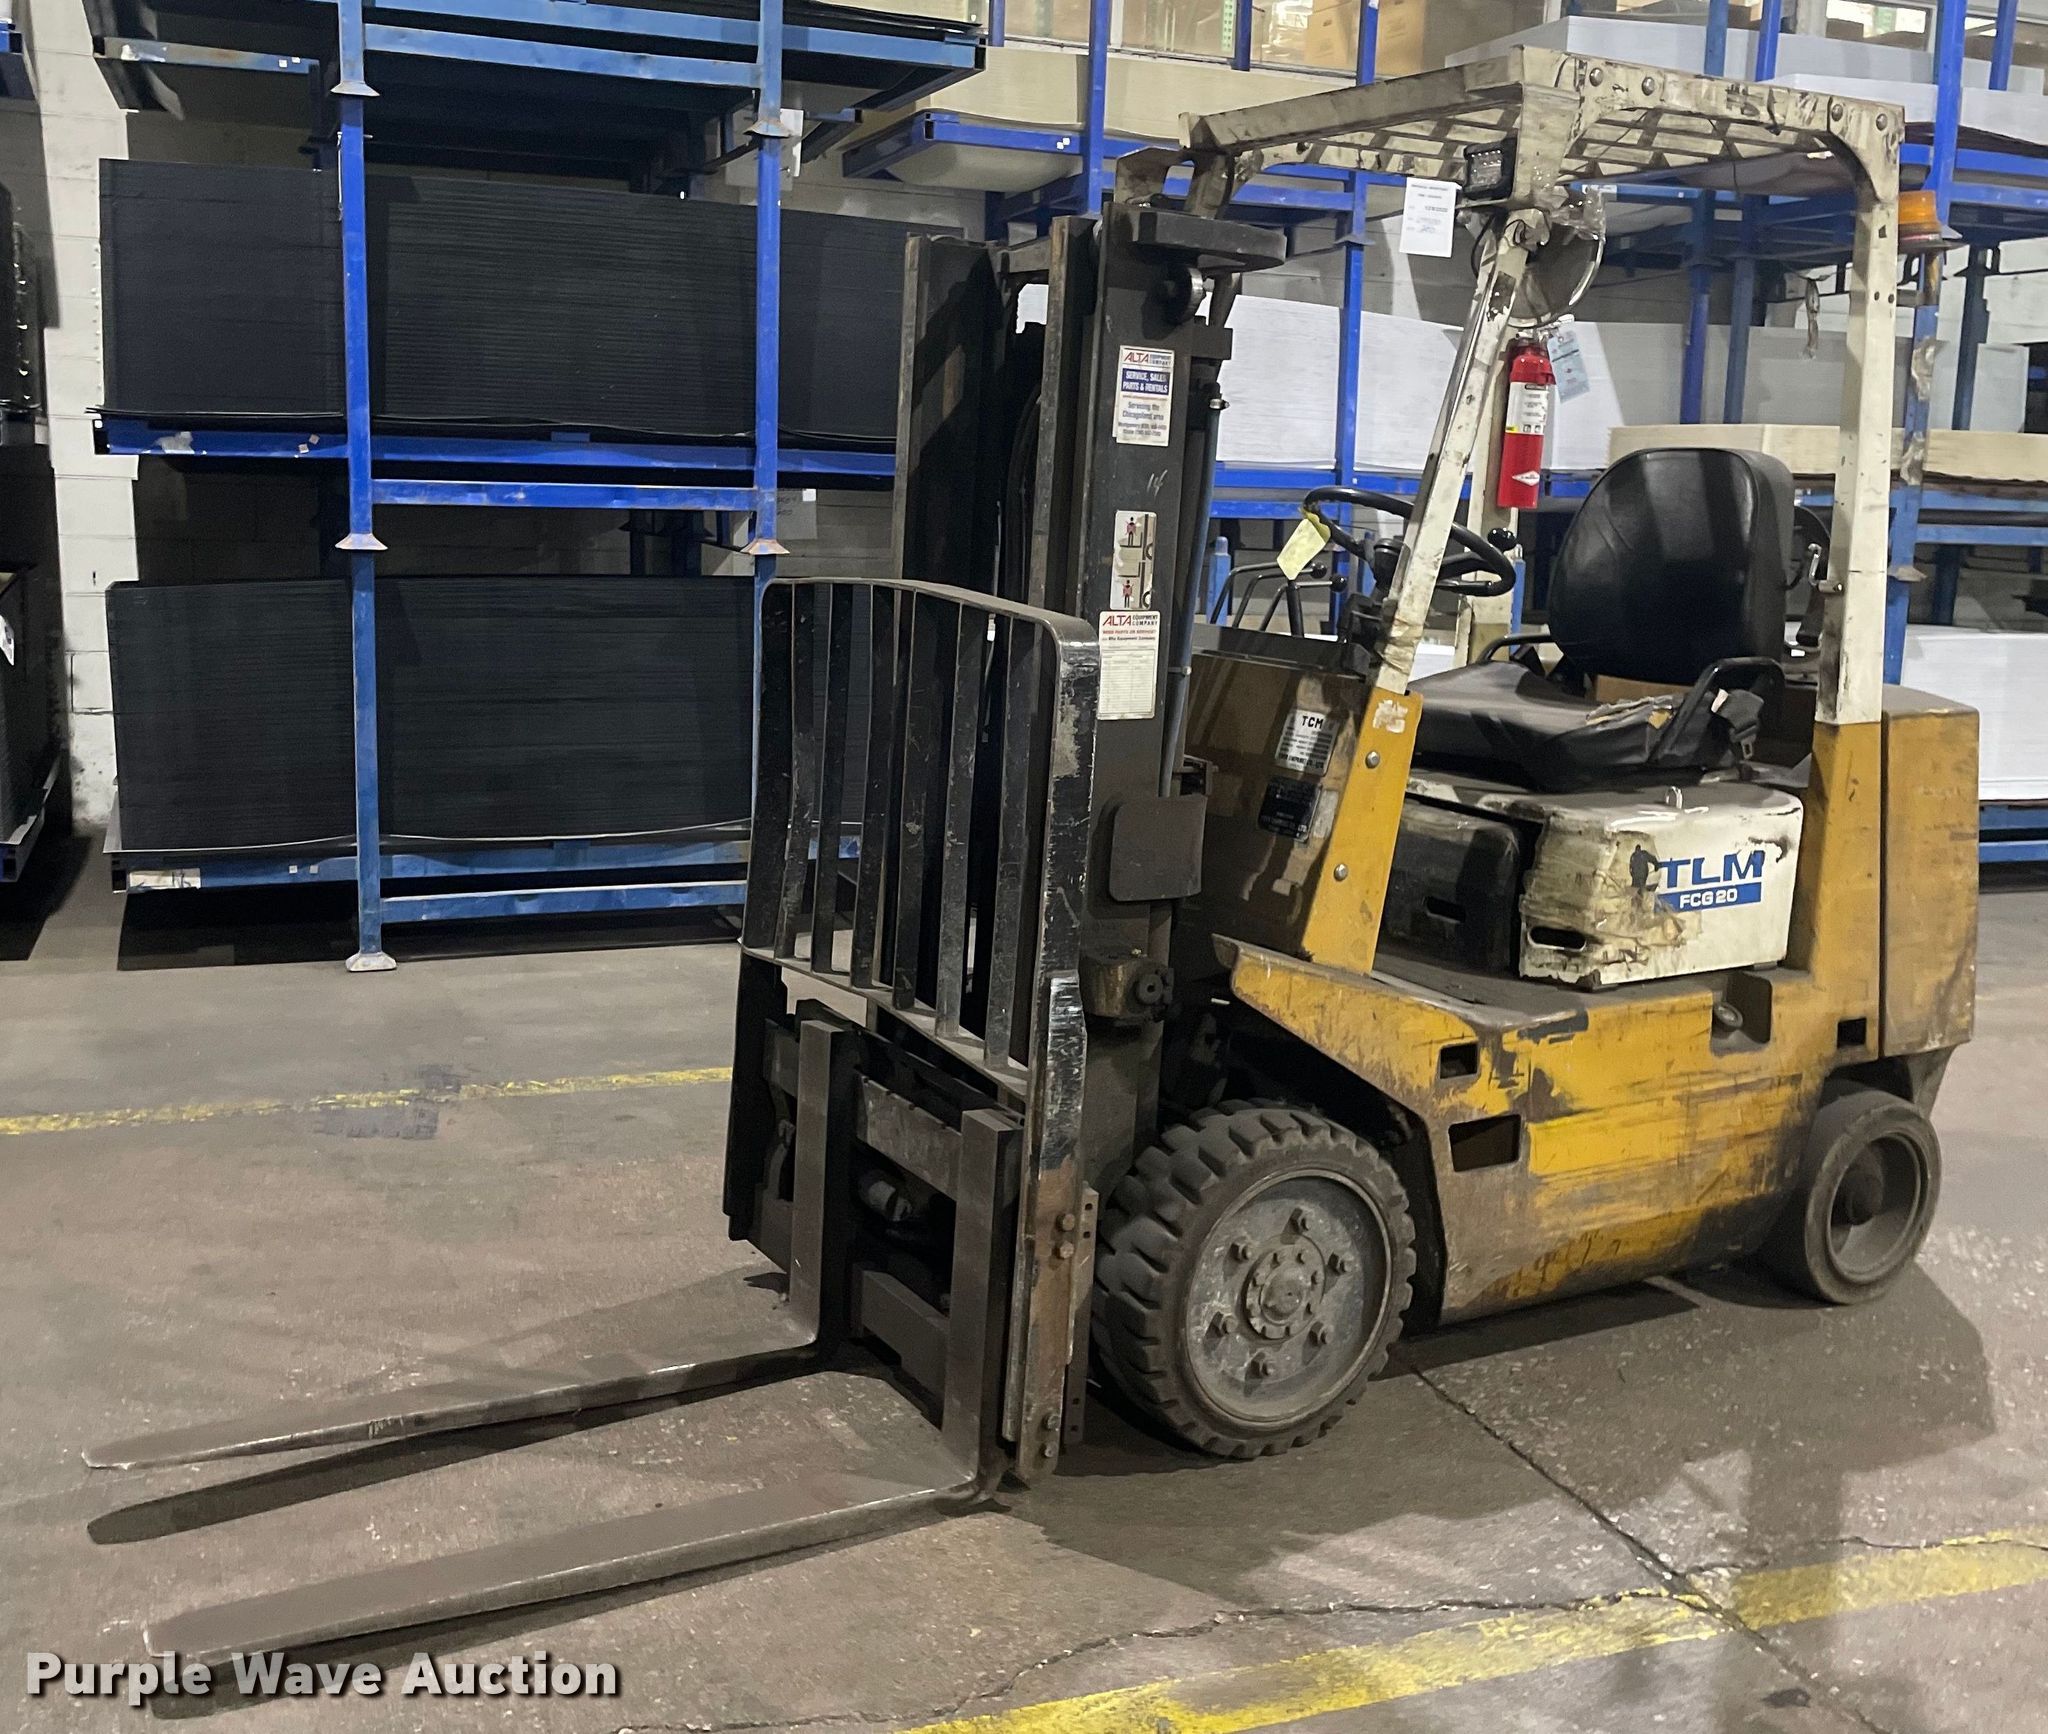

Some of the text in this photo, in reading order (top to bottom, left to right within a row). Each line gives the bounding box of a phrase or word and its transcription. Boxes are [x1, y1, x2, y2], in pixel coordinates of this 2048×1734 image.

[1124, 352, 1149, 363] ALTA
[1122, 381, 1139, 391] PARTS
[1145, 383, 1168, 393] RENTALS
[1103, 615, 1131, 626] ALTA
[1302, 716, 1324, 729] TCM
[1658, 850, 1765, 888] TLM
[1680, 888, 1738, 909] FCG 20
